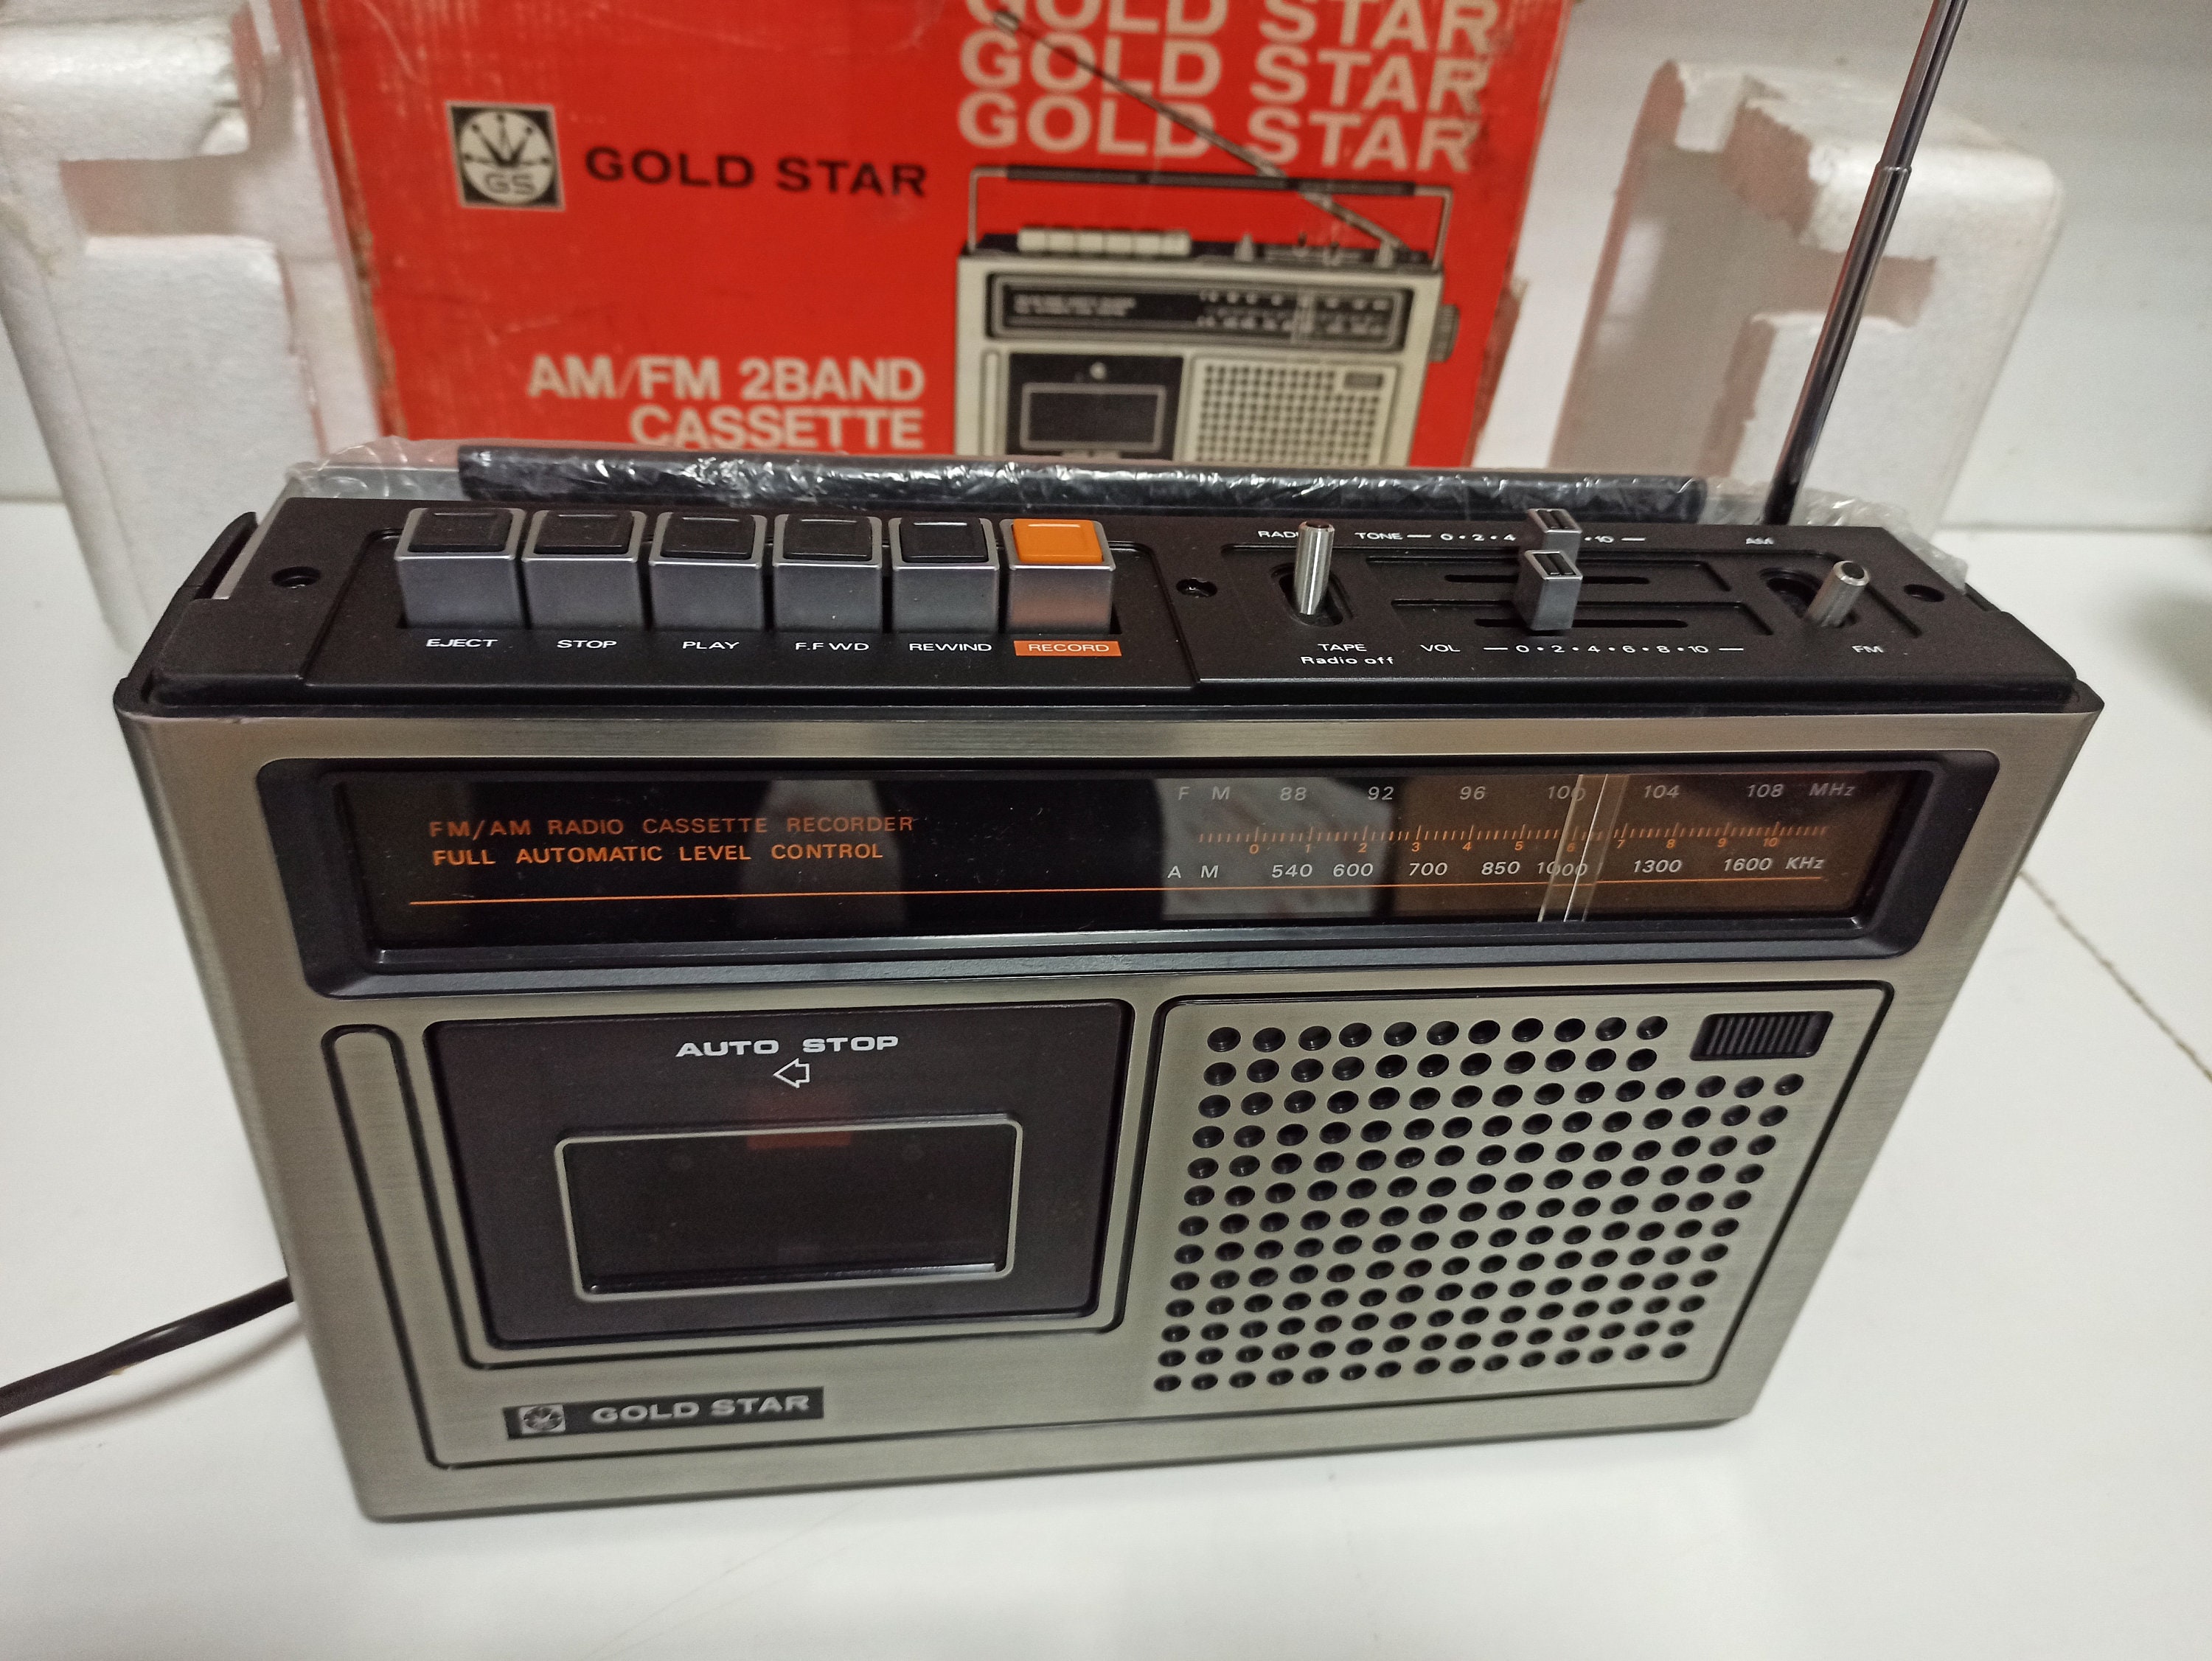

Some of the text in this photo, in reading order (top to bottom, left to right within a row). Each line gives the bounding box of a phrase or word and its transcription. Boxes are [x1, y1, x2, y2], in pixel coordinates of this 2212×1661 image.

[1259, 0, 1498, 52] STAR
[961, 28, 1490, 114] GOLD STAR
[958, 91, 1481, 173] GOLD STAR
[585, 147, 928, 197] GOLD STAR
[484, 173, 536, 195] GS
[528, 354, 925, 401] AM/FM 2BAND
[630, 406, 924, 449] CASSETTE
[1354, 532, 1403, 540] TONE
[425, 638, 498, 648] EJECT
[556, 639, 617, 649] STOP
[682, 641, 740, 650] PLAY
[908, 642, 992, 652] REWIND
[1028, 643, 1110, 653] RECORD
[1318, 643, 1367, 652] TAPE
[1420, 644, 1461, 652] VOL
[1851, 645, 1884, 654] FM
[1301, 655, 1394, 665] Radio off
[1280, 787, 1307, 801] 88
[1368, 786, 1394, 801] 92
[1459, 786, 1486, 800] 96
[1548, 785, 1585, 801] 100
[1644, 784, 1680, 798] 104
[1746, 784, 1784, 798] 108
[1809, 782, 1856, 796] MHz
[430, 815, 914, 841] FM/AM RADIO CASSETTE RECORDER
[432, 843, 883, 866] FULL AUTOMATIC LEVEL CONTROL
[1358, 843, 1368, 853] 2
[1411, 842, 1421, 852] 3
[1462, 841, 1472, 852] 4
[1514, 840, 1524, 851] 5
[1566, 842, 1576, 853] 6
[1617, 839, 1626, 849] 7
[1666, 838, 1676, 849] 8
[1717, 838, 1728, 848] 9
[1763, 838, 1780, 848] 10
[1271, 863, 1313, 878] 540
[1332, 863, 1374, 877] 600
[1409, 862, 1448, 876] 700
[1481, 861, 1520, 875] 850
[1537, 861, 1588, 877] 1000
[1633, 859, 1683, 873] 1300
[1724, 857, 1773, 871] 1600
[1784, 856, 1826, 870] KHz
[675, 1036, 899, 1057] AUTO STOP
[591, 1395, 810, 1424] GOLD STAR
